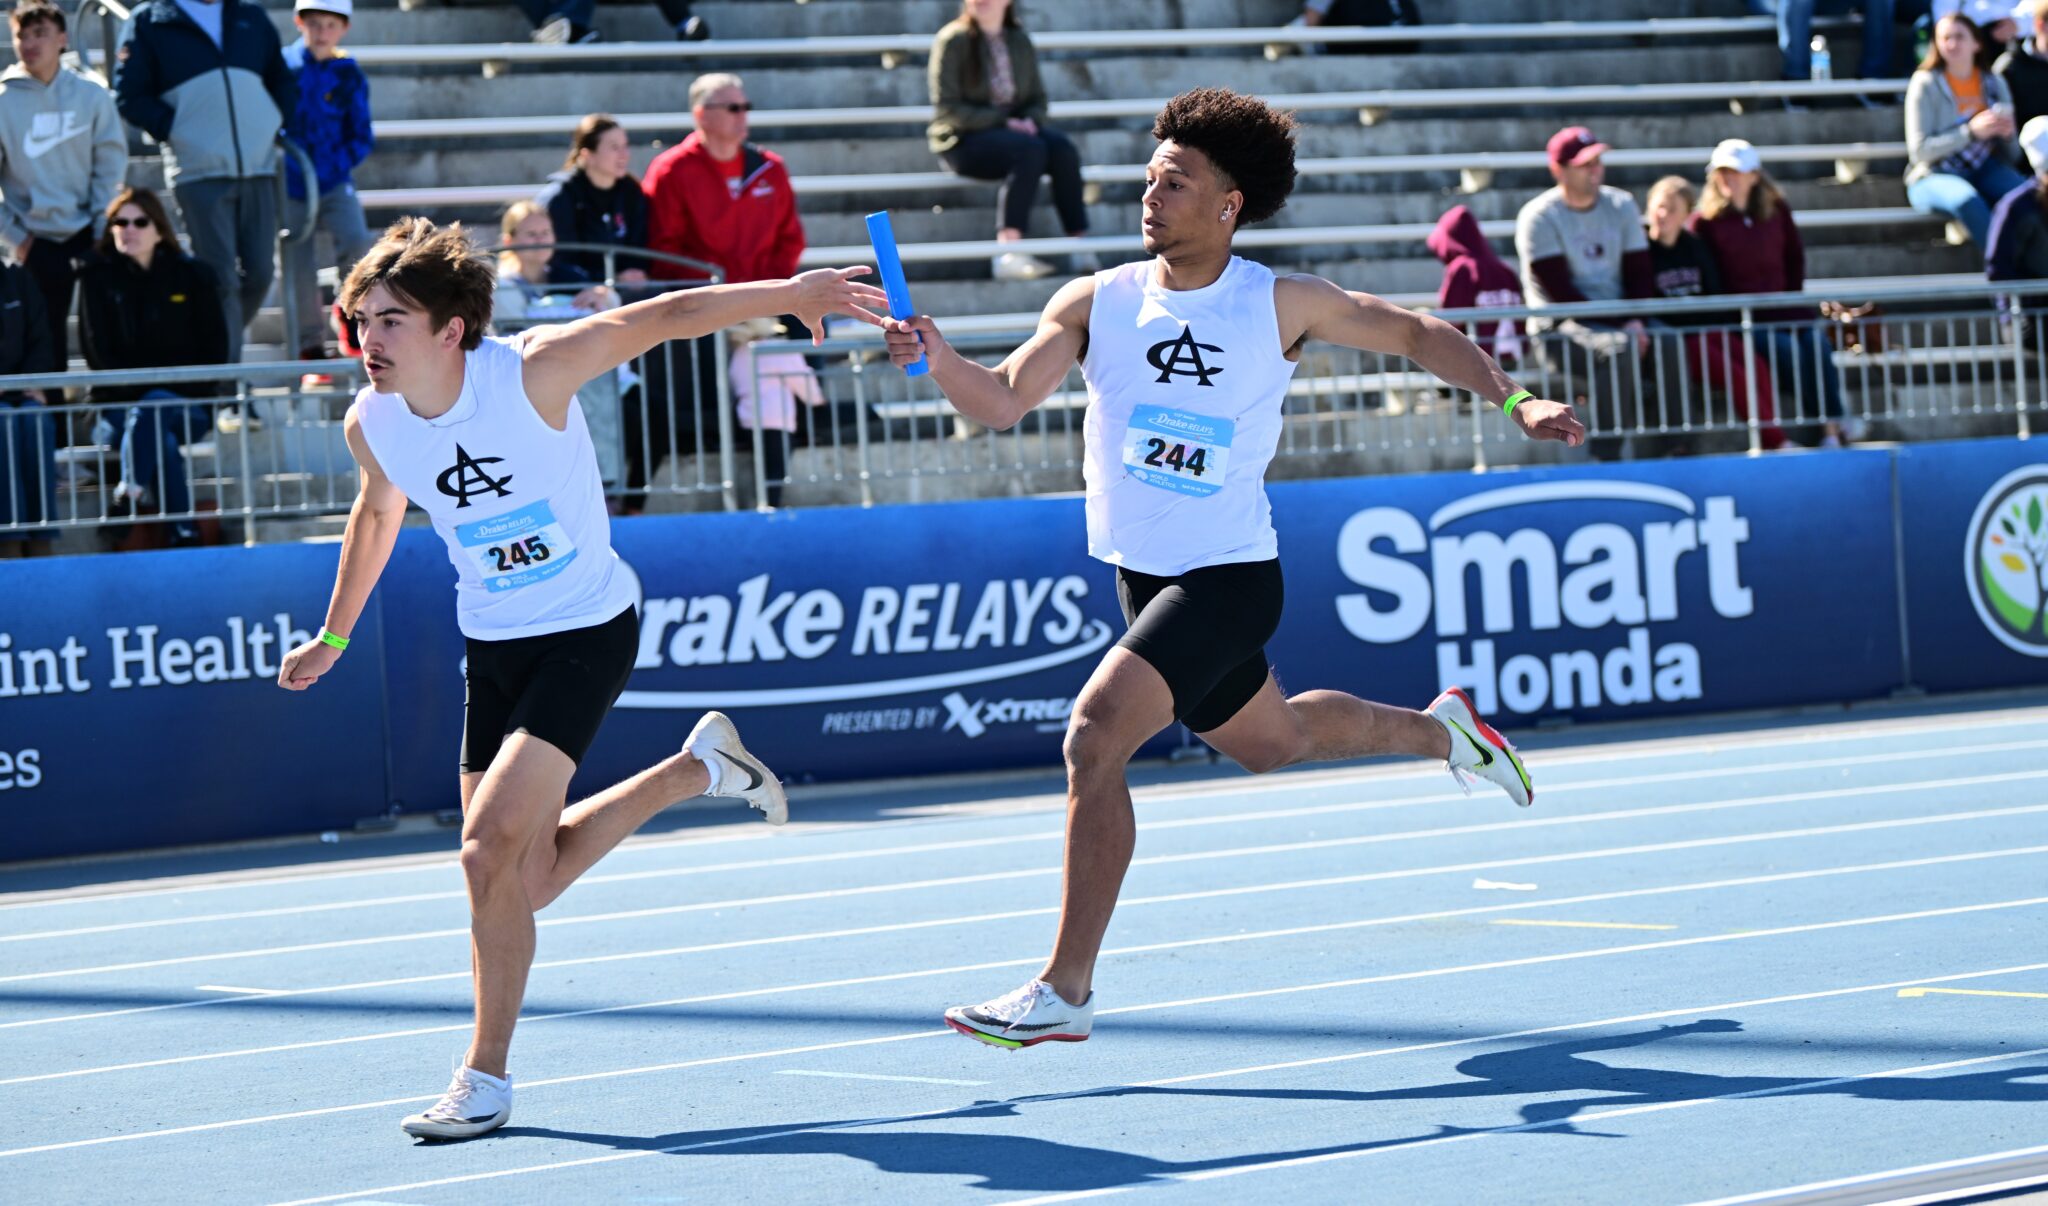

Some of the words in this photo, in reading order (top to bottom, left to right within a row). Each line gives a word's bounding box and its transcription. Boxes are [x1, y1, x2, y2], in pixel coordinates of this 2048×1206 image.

[1156, 413, 1188, 429] Drake
[1188, 423, 1214, 434] RELAYS
[1144, 437, 1206, 477] 244
[478, 524, 508, 536] Drake
[488, 536, 550, 572] 245
[1335, 496, 1754, 644] Smart
[607, 558, 844, 669] rake
[851, 574, 1089, 656] RELAYS
[1436, 627, 1703, 716] Honda
[822, 707, 913, 734] PRESENTED
[914, 706, 938, 729] BY
